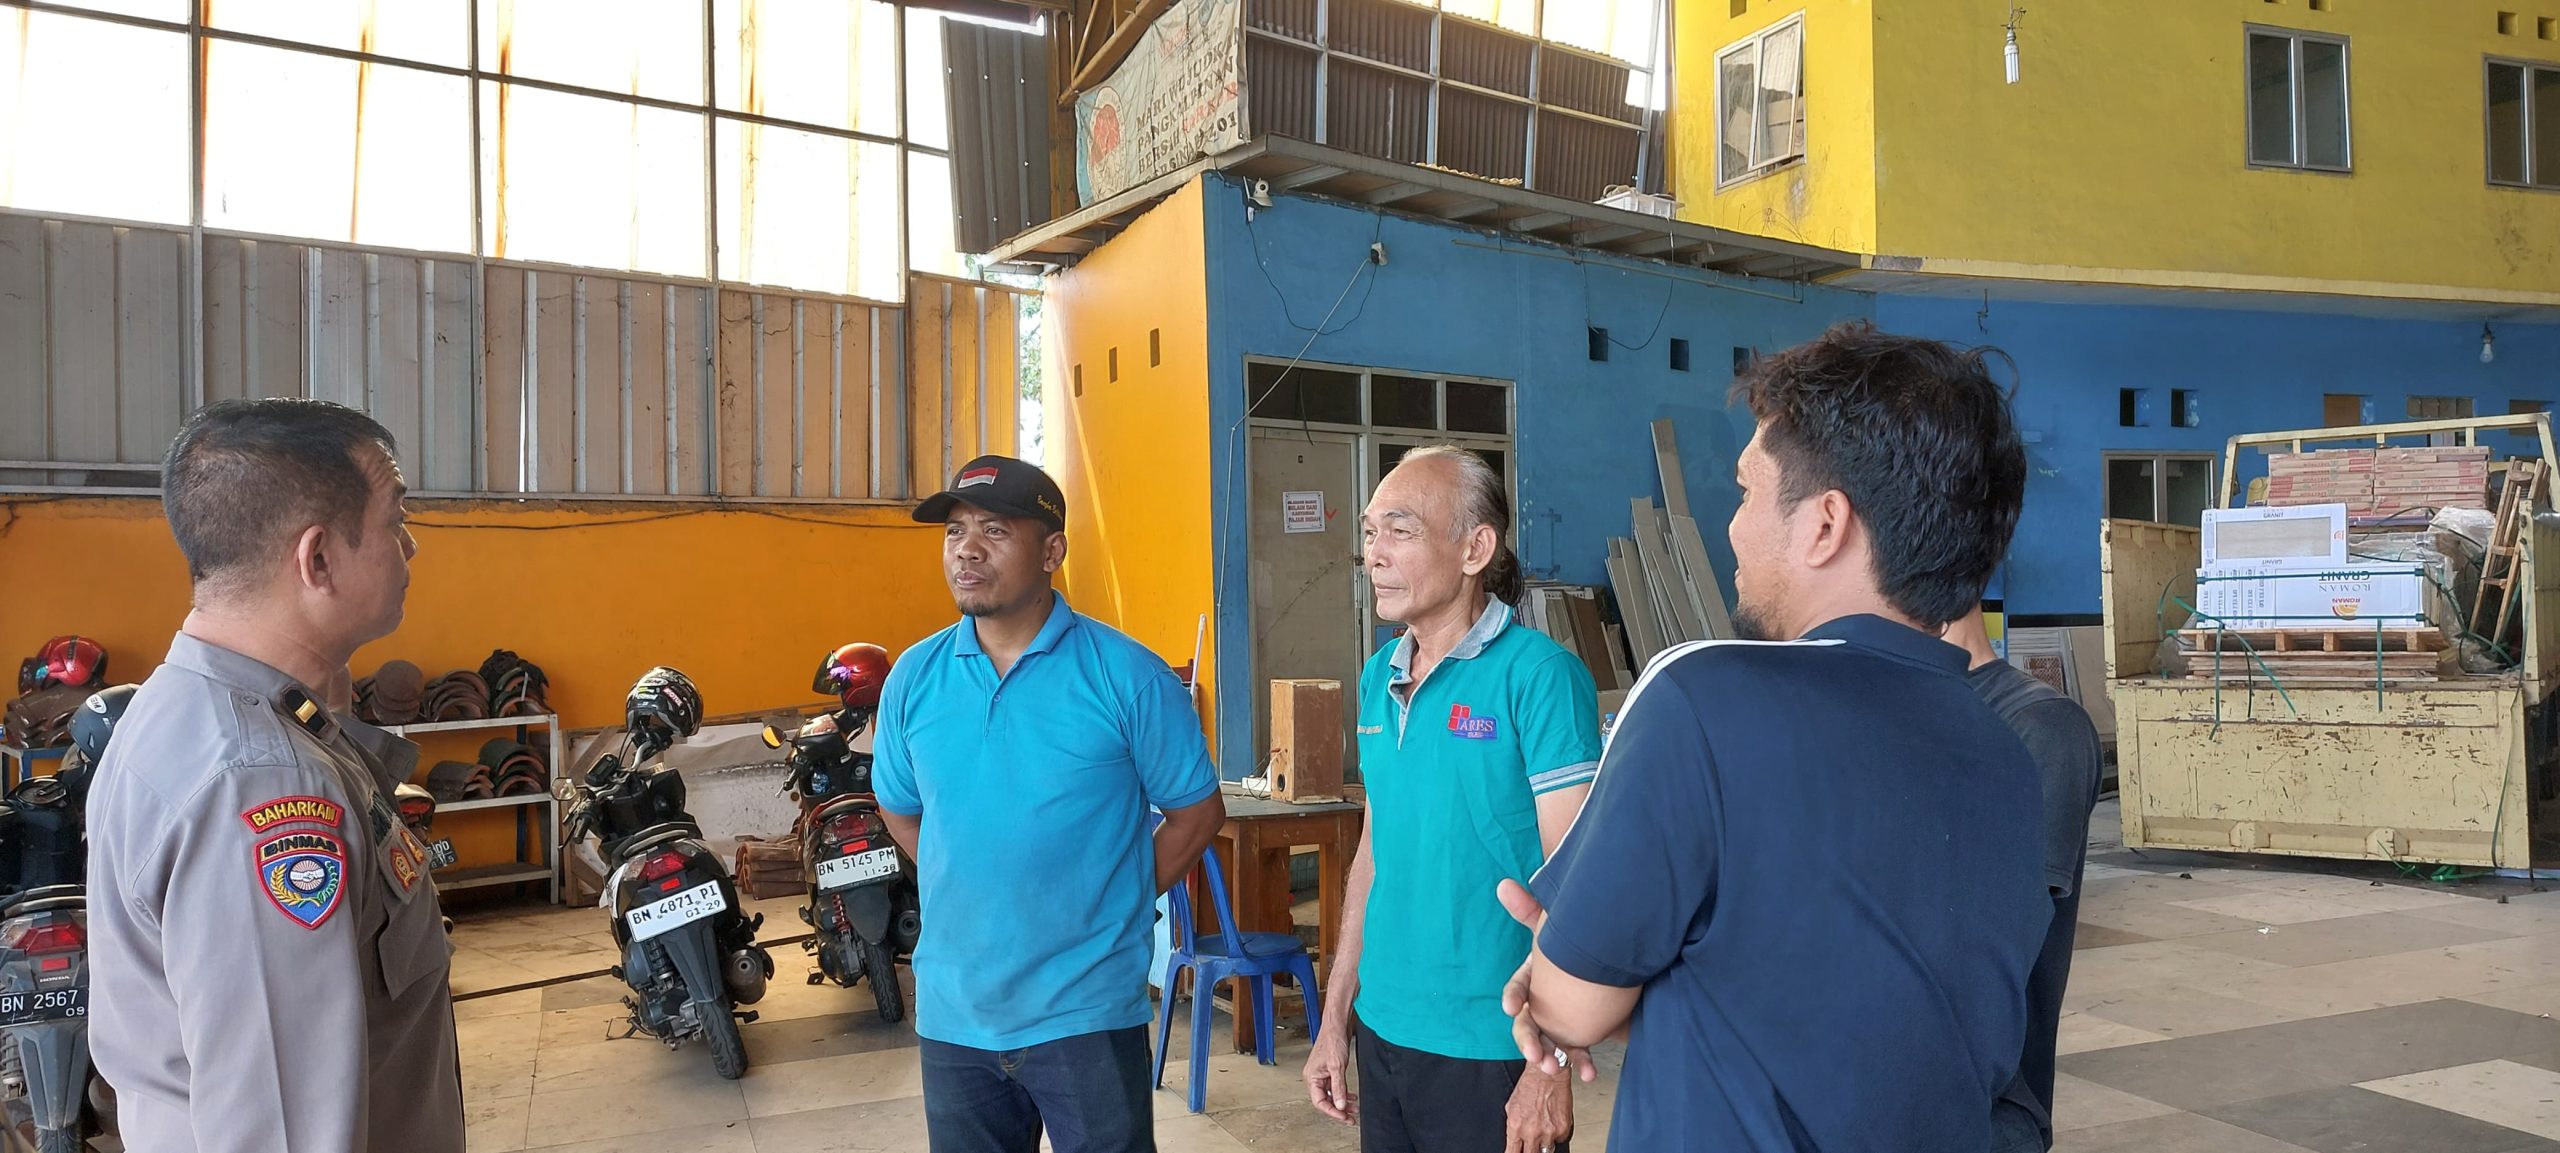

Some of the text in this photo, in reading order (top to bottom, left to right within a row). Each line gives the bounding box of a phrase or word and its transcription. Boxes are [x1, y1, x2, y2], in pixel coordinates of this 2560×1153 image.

[1136, 93, 1167, 132] MARI
[1138, 128, 1180, 174] BERSIH
[2319, 570, 2370, 581] GRANIT
[2319, 583, 2371, 592] ROMAN
[1459, 719, 1494, 732] ARES
[252, 800, 338, 827] BAHARKAM
[263, 835, 339, 857] BINMAS
[818, 848, 895, 876] BN 5145 PM
[632, 884, 718, 925] BN 4871 PI
[1, 989, 78, 1013] BN 2567
[65, 1006, 85, 1017] 09
